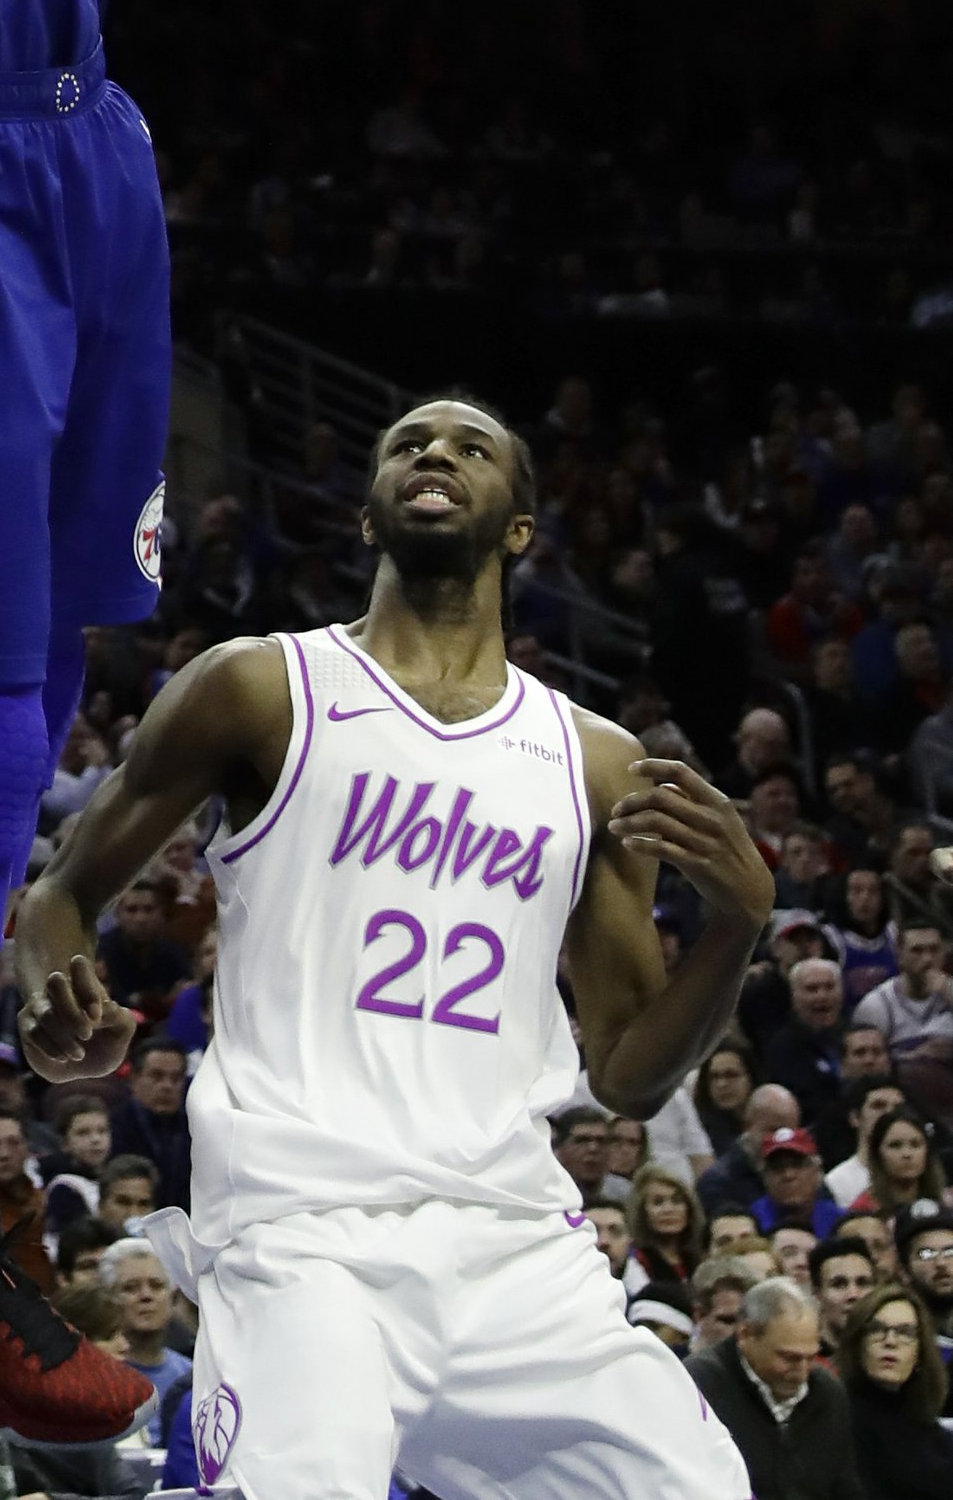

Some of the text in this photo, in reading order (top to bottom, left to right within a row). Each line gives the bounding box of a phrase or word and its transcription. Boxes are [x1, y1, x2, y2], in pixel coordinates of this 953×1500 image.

[520, 739, 564, 766] fitbit
[327, 770, 555, 902] Wolves
[353, 908, 507, 1035] 22
